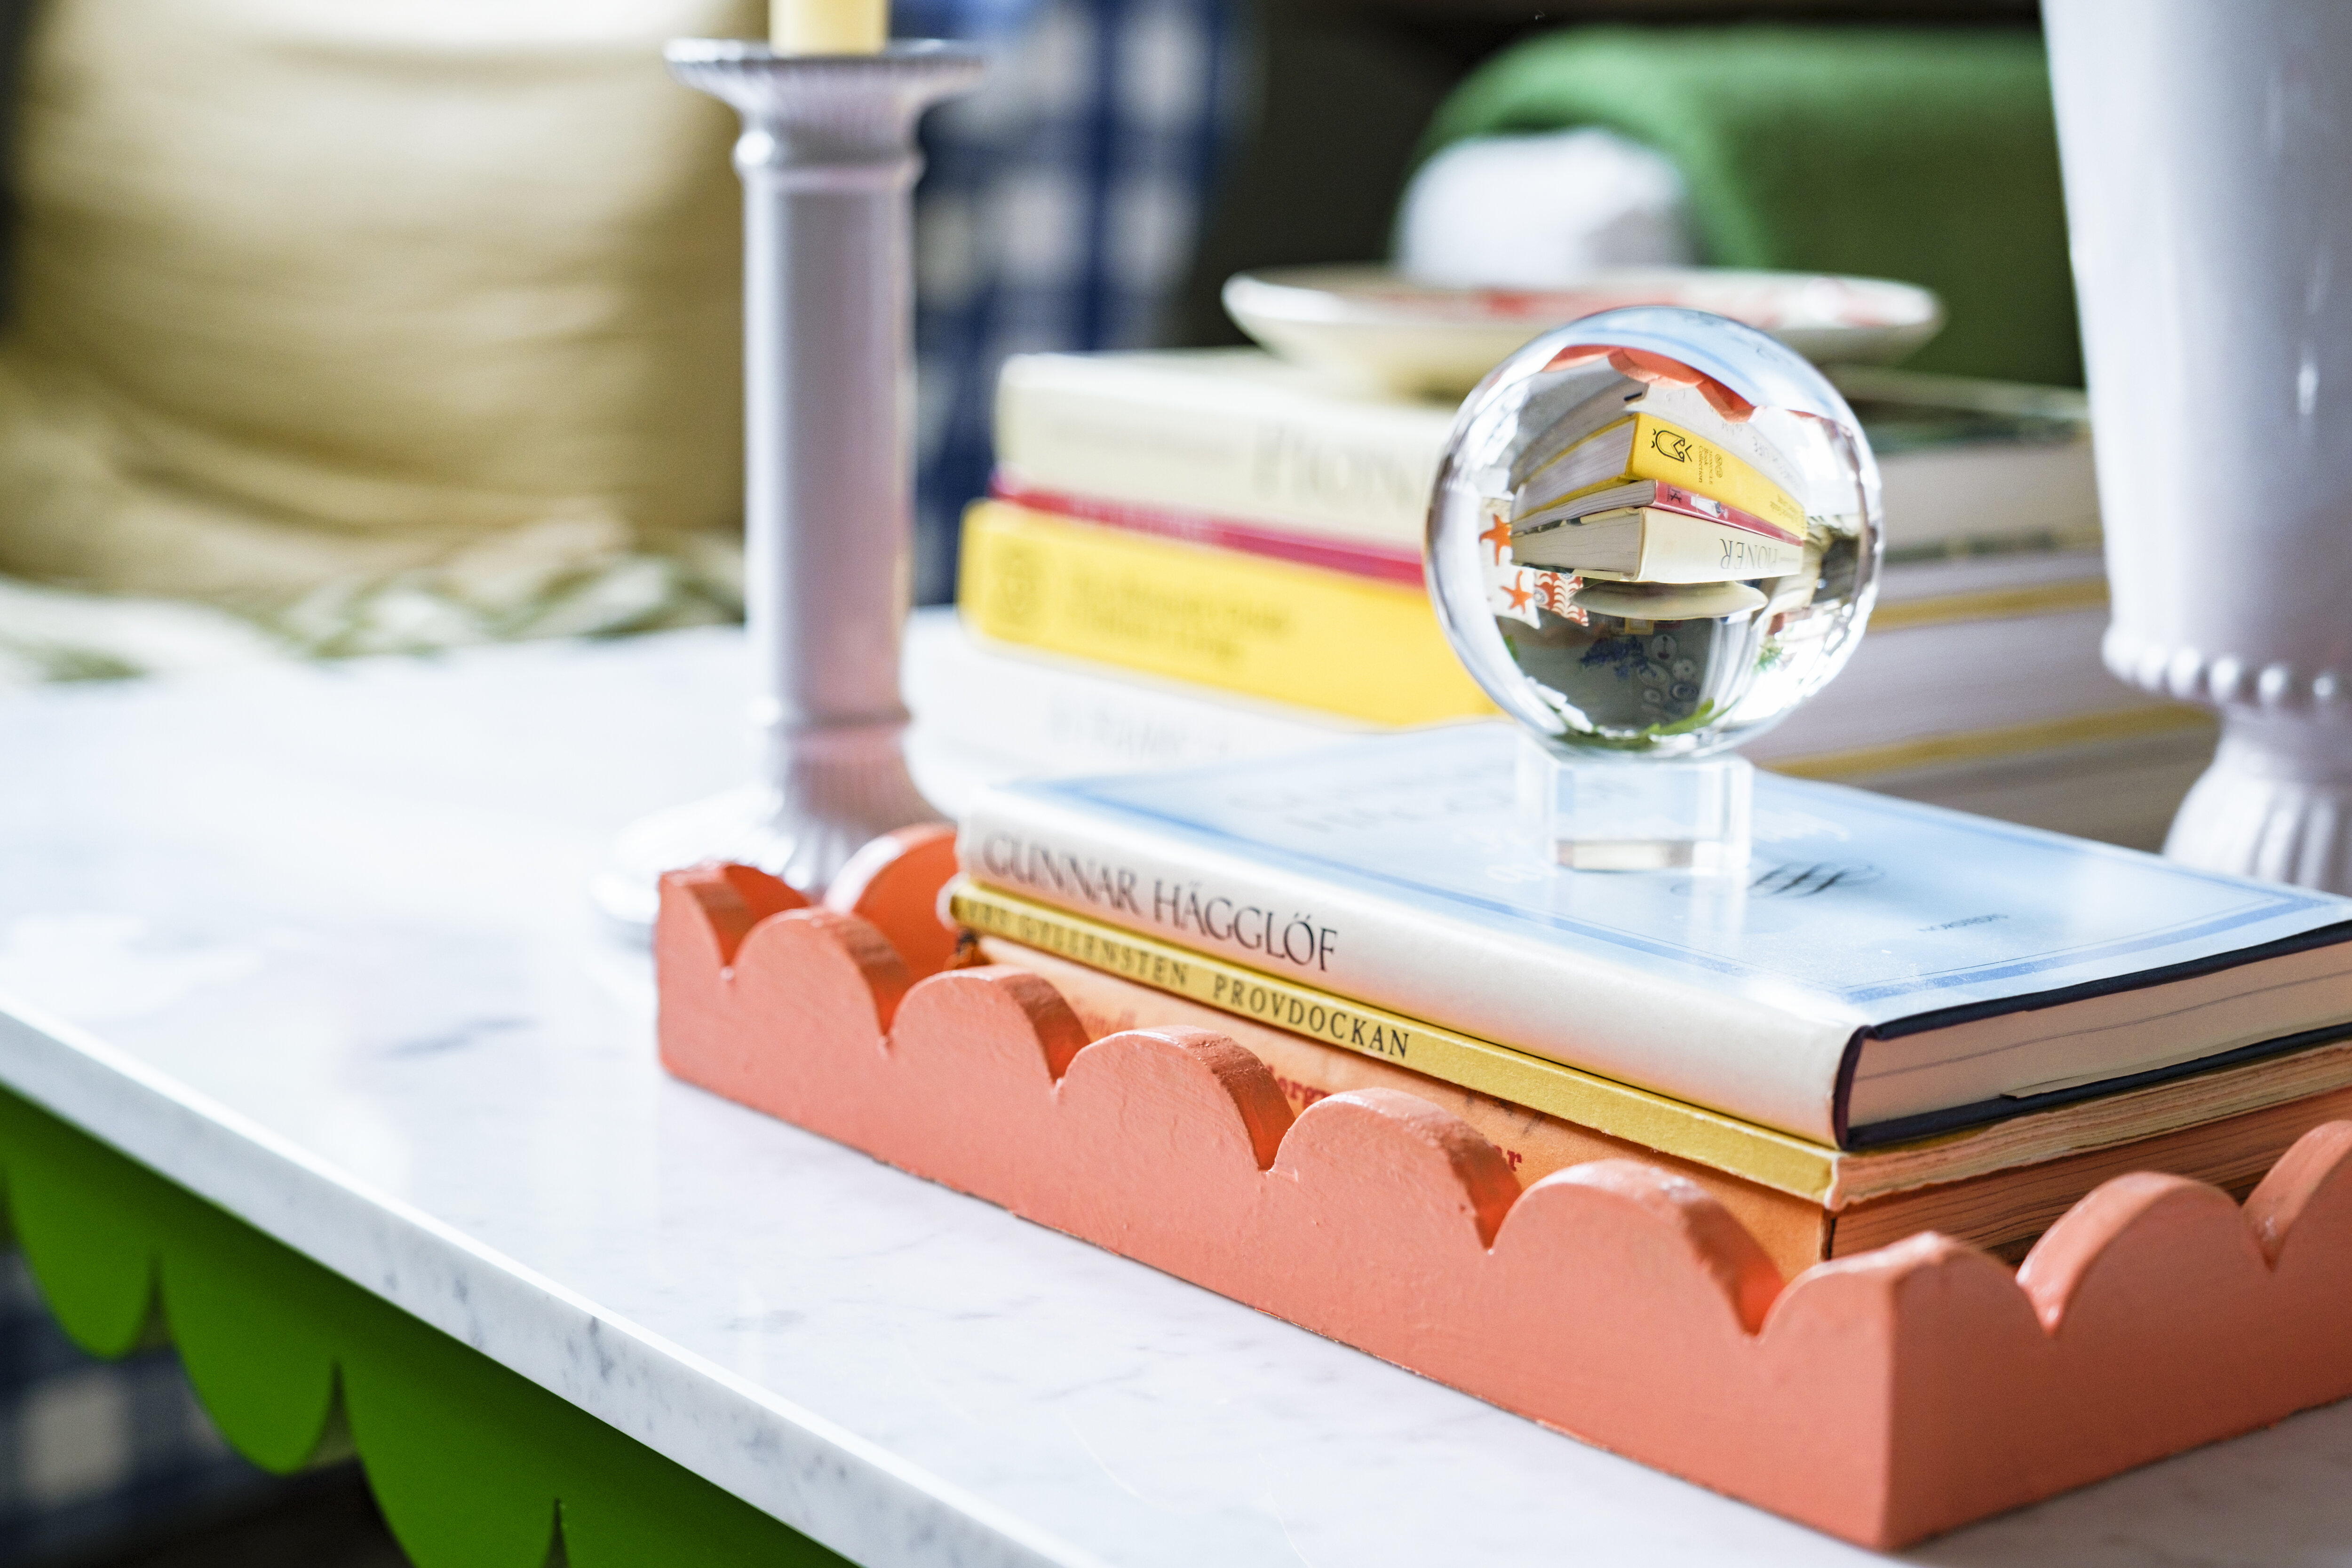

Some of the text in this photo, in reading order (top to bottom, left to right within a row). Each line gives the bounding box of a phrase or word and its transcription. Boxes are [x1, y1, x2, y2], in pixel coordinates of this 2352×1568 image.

[1719, 539, 1778, 573] PIONER
[983, 831, 1338, 972] GUNNAR HÄGGLÖF
[1212, 974, 1409, 1059] PROVDOCKAN
